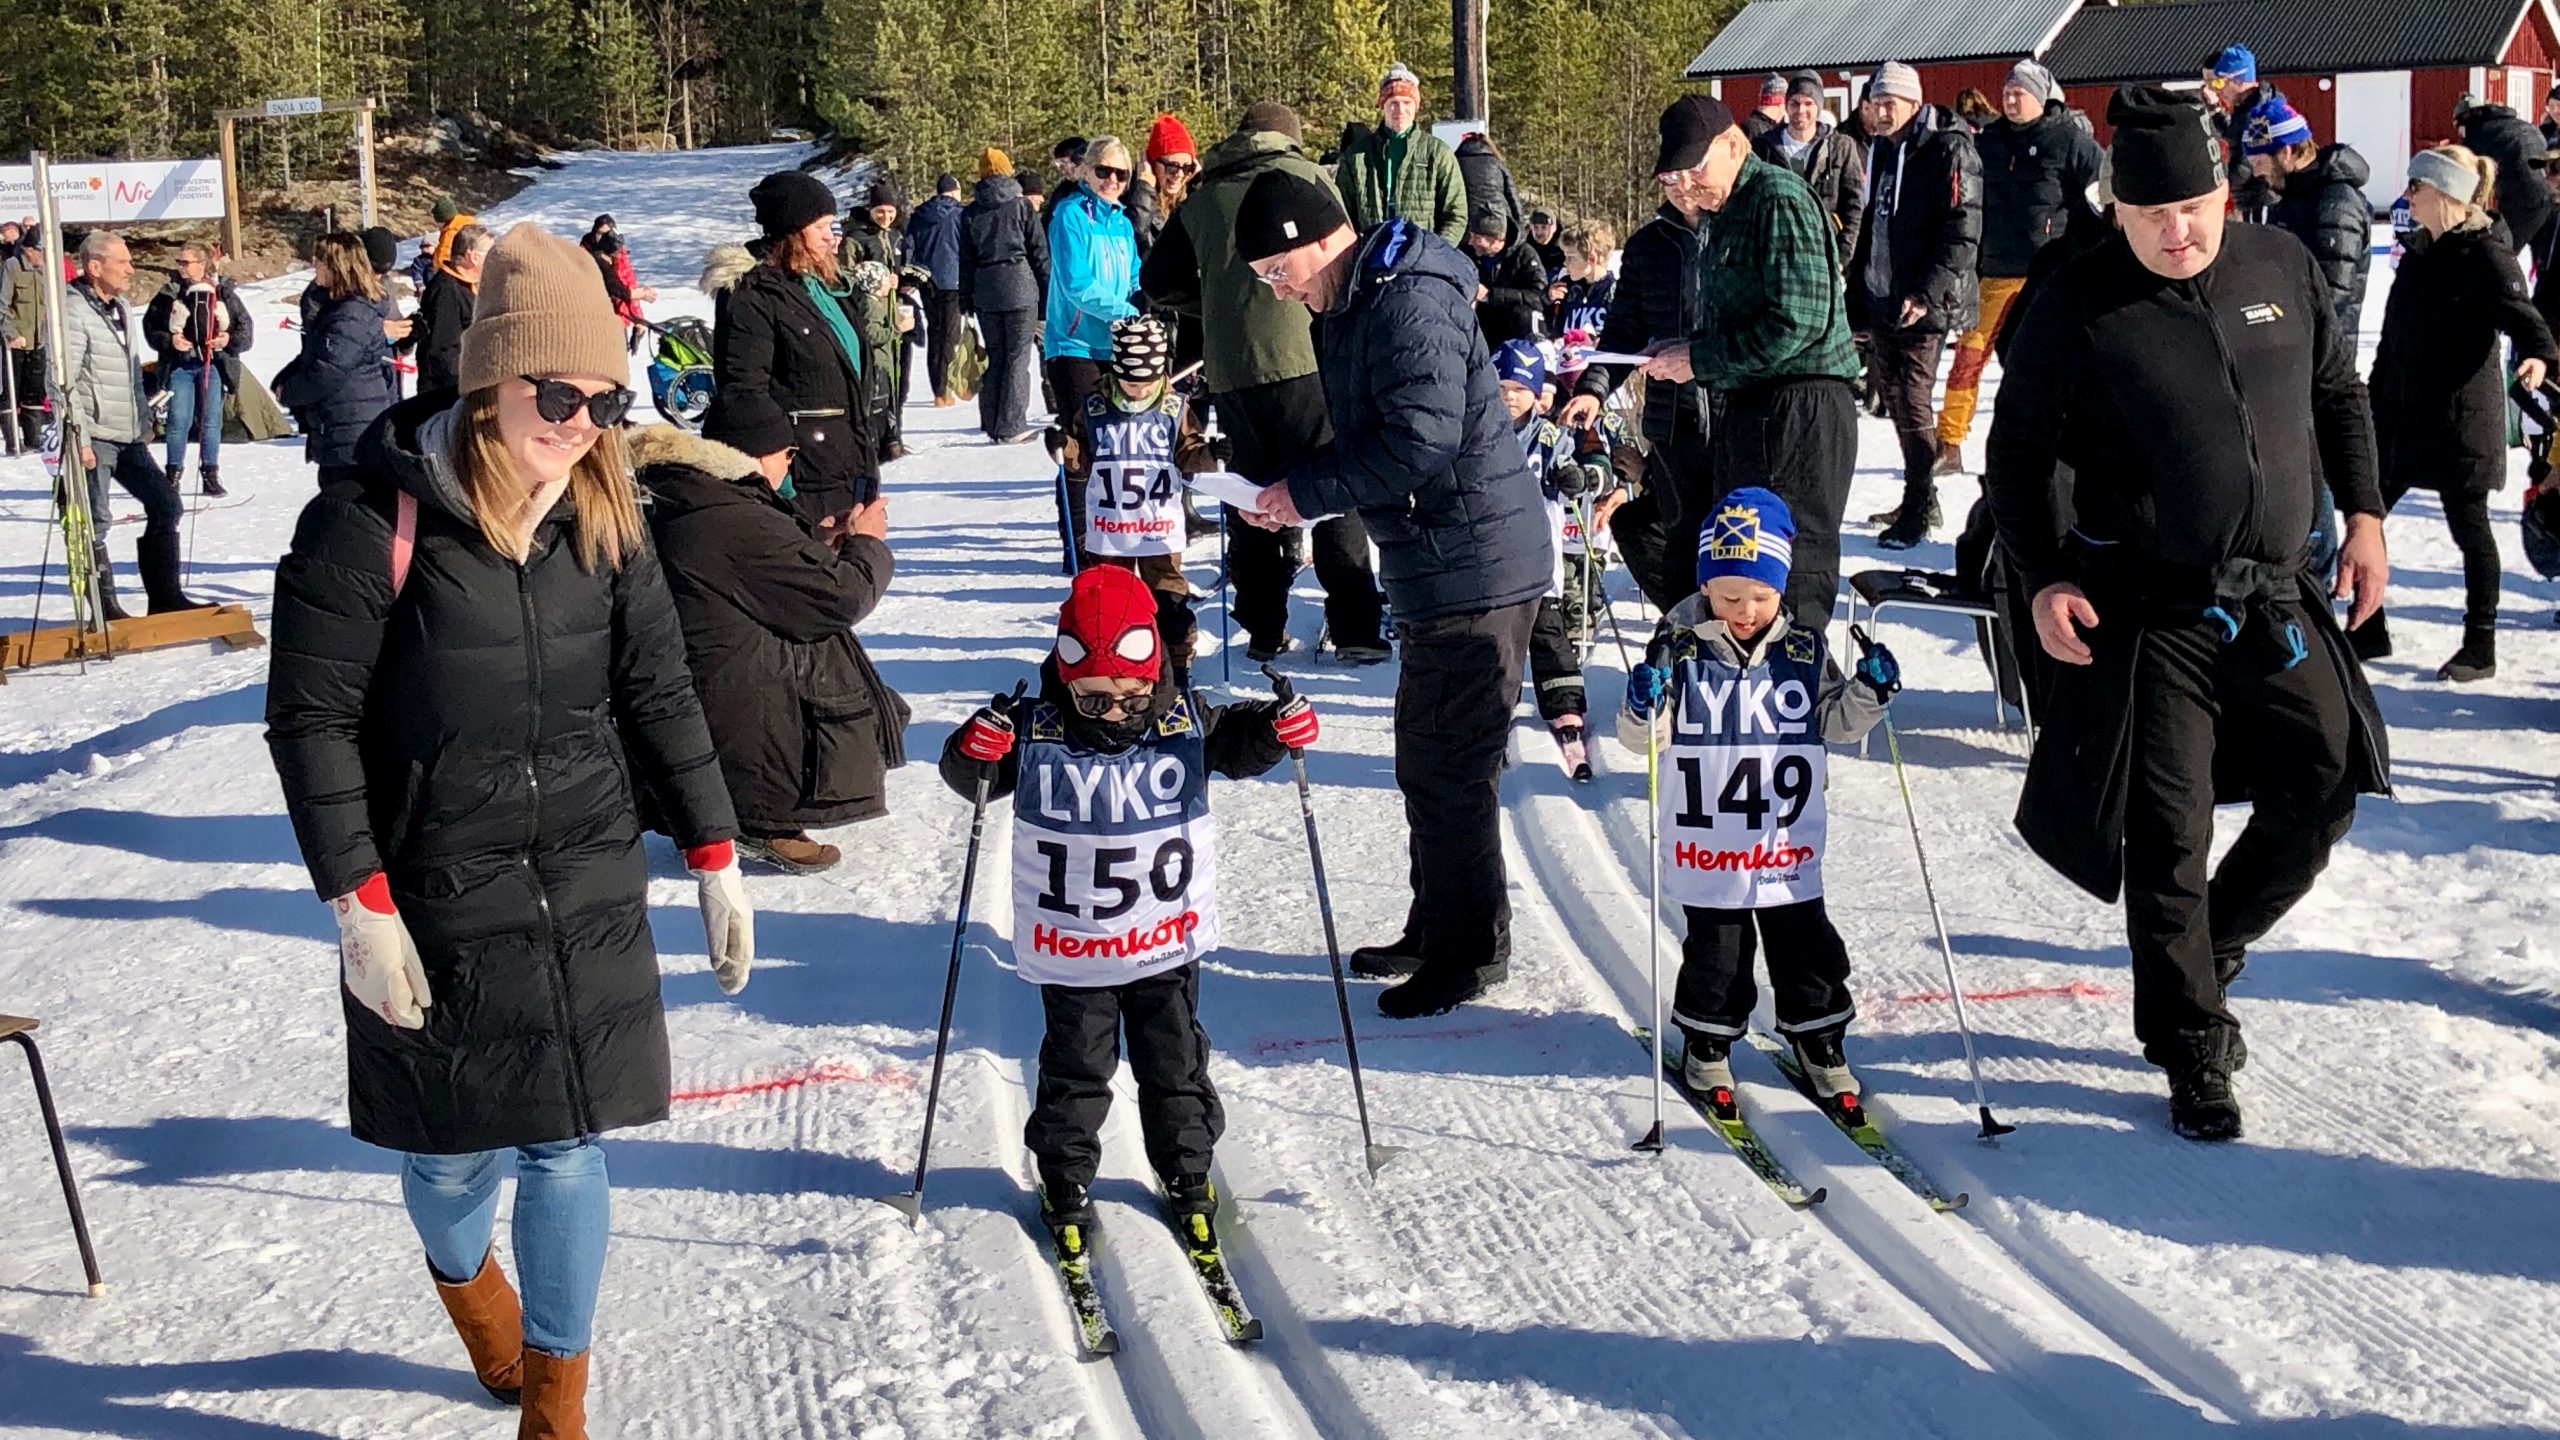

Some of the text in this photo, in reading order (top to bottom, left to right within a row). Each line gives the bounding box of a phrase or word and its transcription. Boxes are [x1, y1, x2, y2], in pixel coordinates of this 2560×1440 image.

[0, 180, 37, 192] Svens
[1096, 422, 1170, 457] LYKO
[1097, 467, 1173, 510] 154
[1094, 515, 1176, 535] Hemköp
[1677, 679, 1812, 735] LYKO
[1038, 756, 1187, 823] LYKO
[1675, 754, 1813, 830] 149
[1036, 837, 1195, 920] 150
[1674, 840, 1815, 872] Hemköp
[1032, 910, 1200, 959] Hemköp
